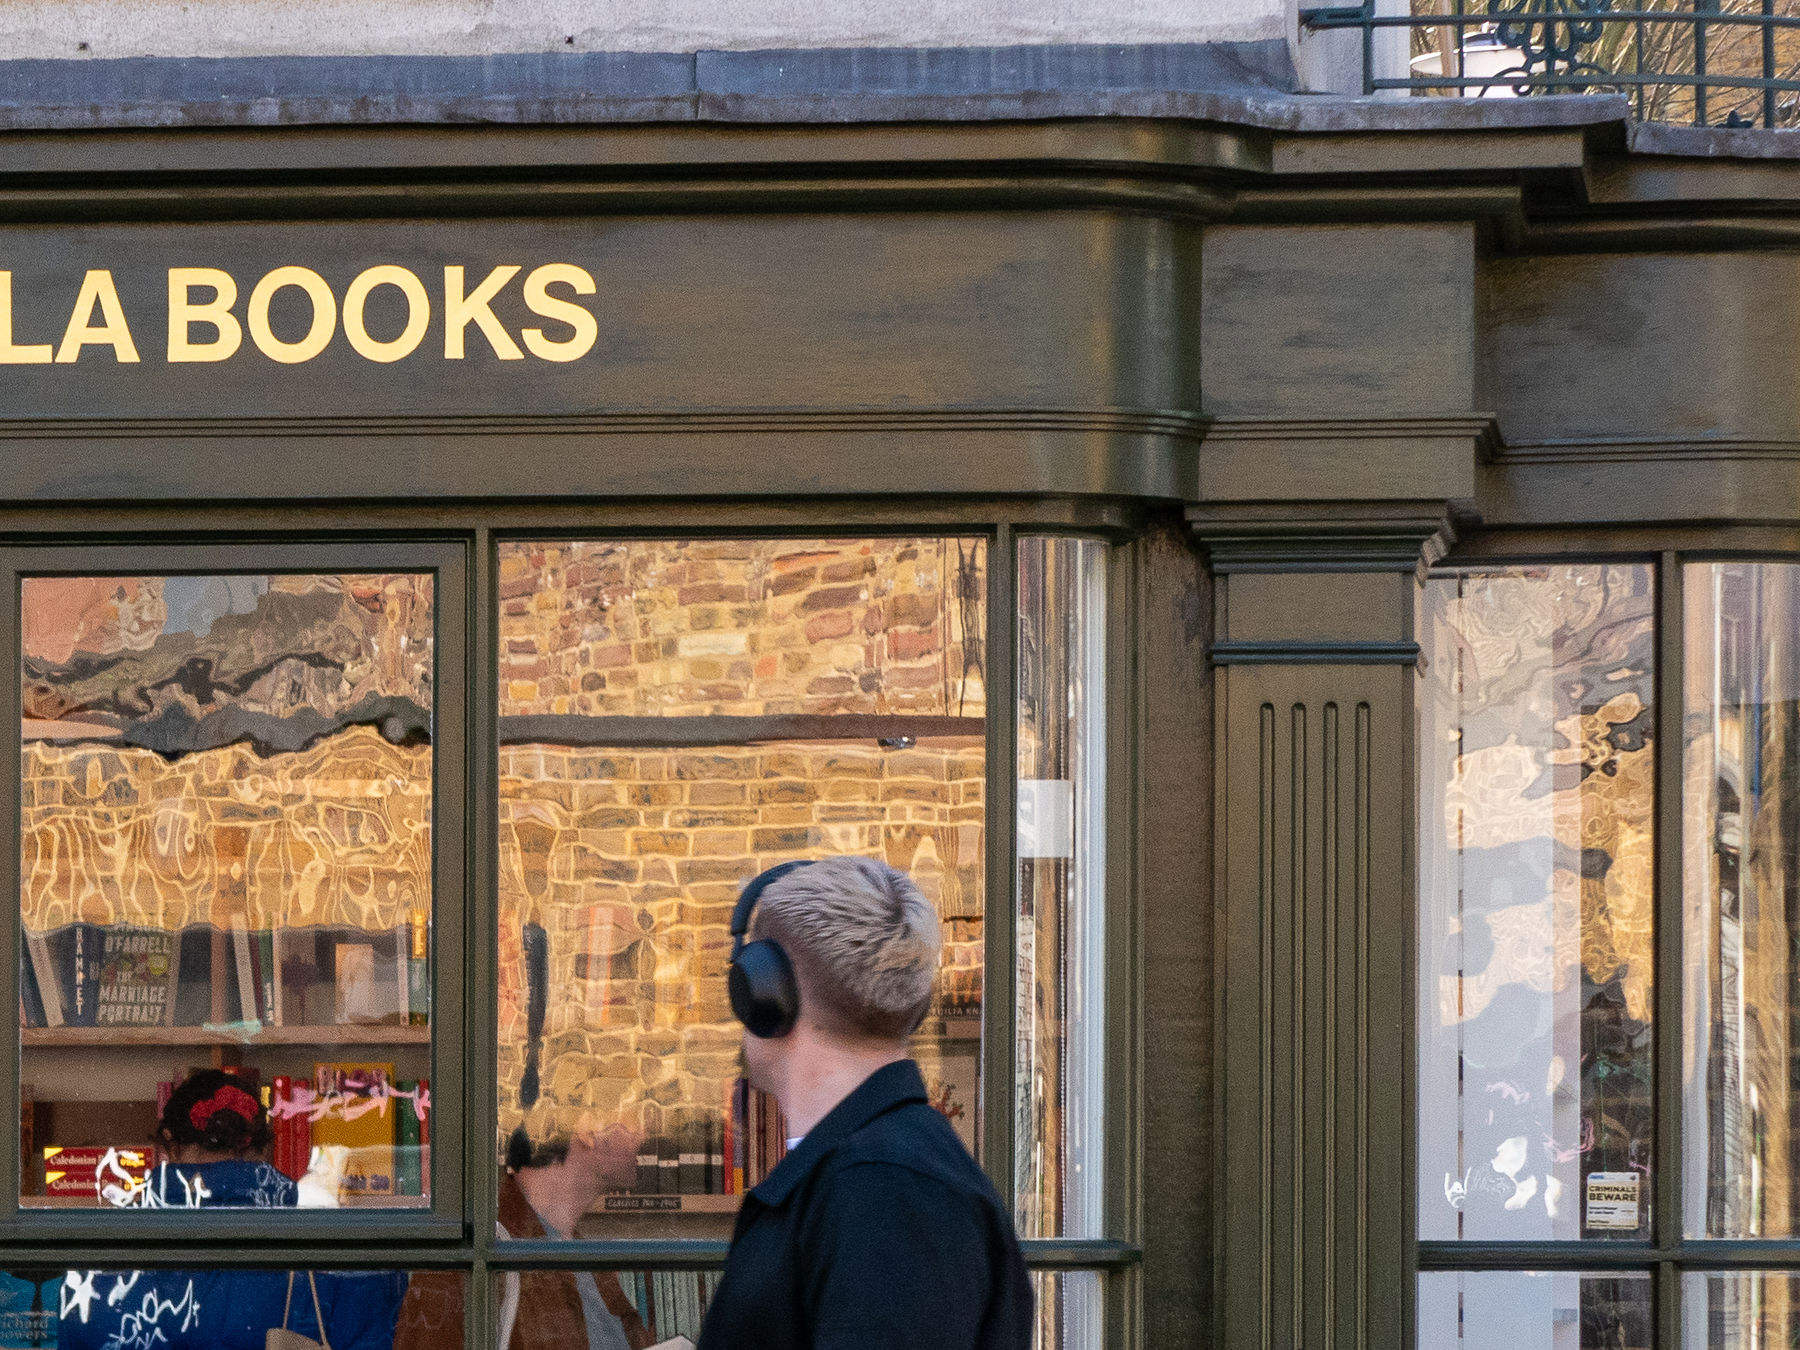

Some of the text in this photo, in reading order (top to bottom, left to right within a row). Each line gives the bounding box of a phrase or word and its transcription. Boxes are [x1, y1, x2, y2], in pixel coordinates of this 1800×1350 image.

[166, 262, 598, 364] BOOKS
[100, 985, 167, 1003] MARRIAGE
[97, 1004, 163, 1023] PORTRAIT
[1589, 1185, 1637, 1193] CRIMINALS
[1589, 1193, 1637, 1202] BEWARE
